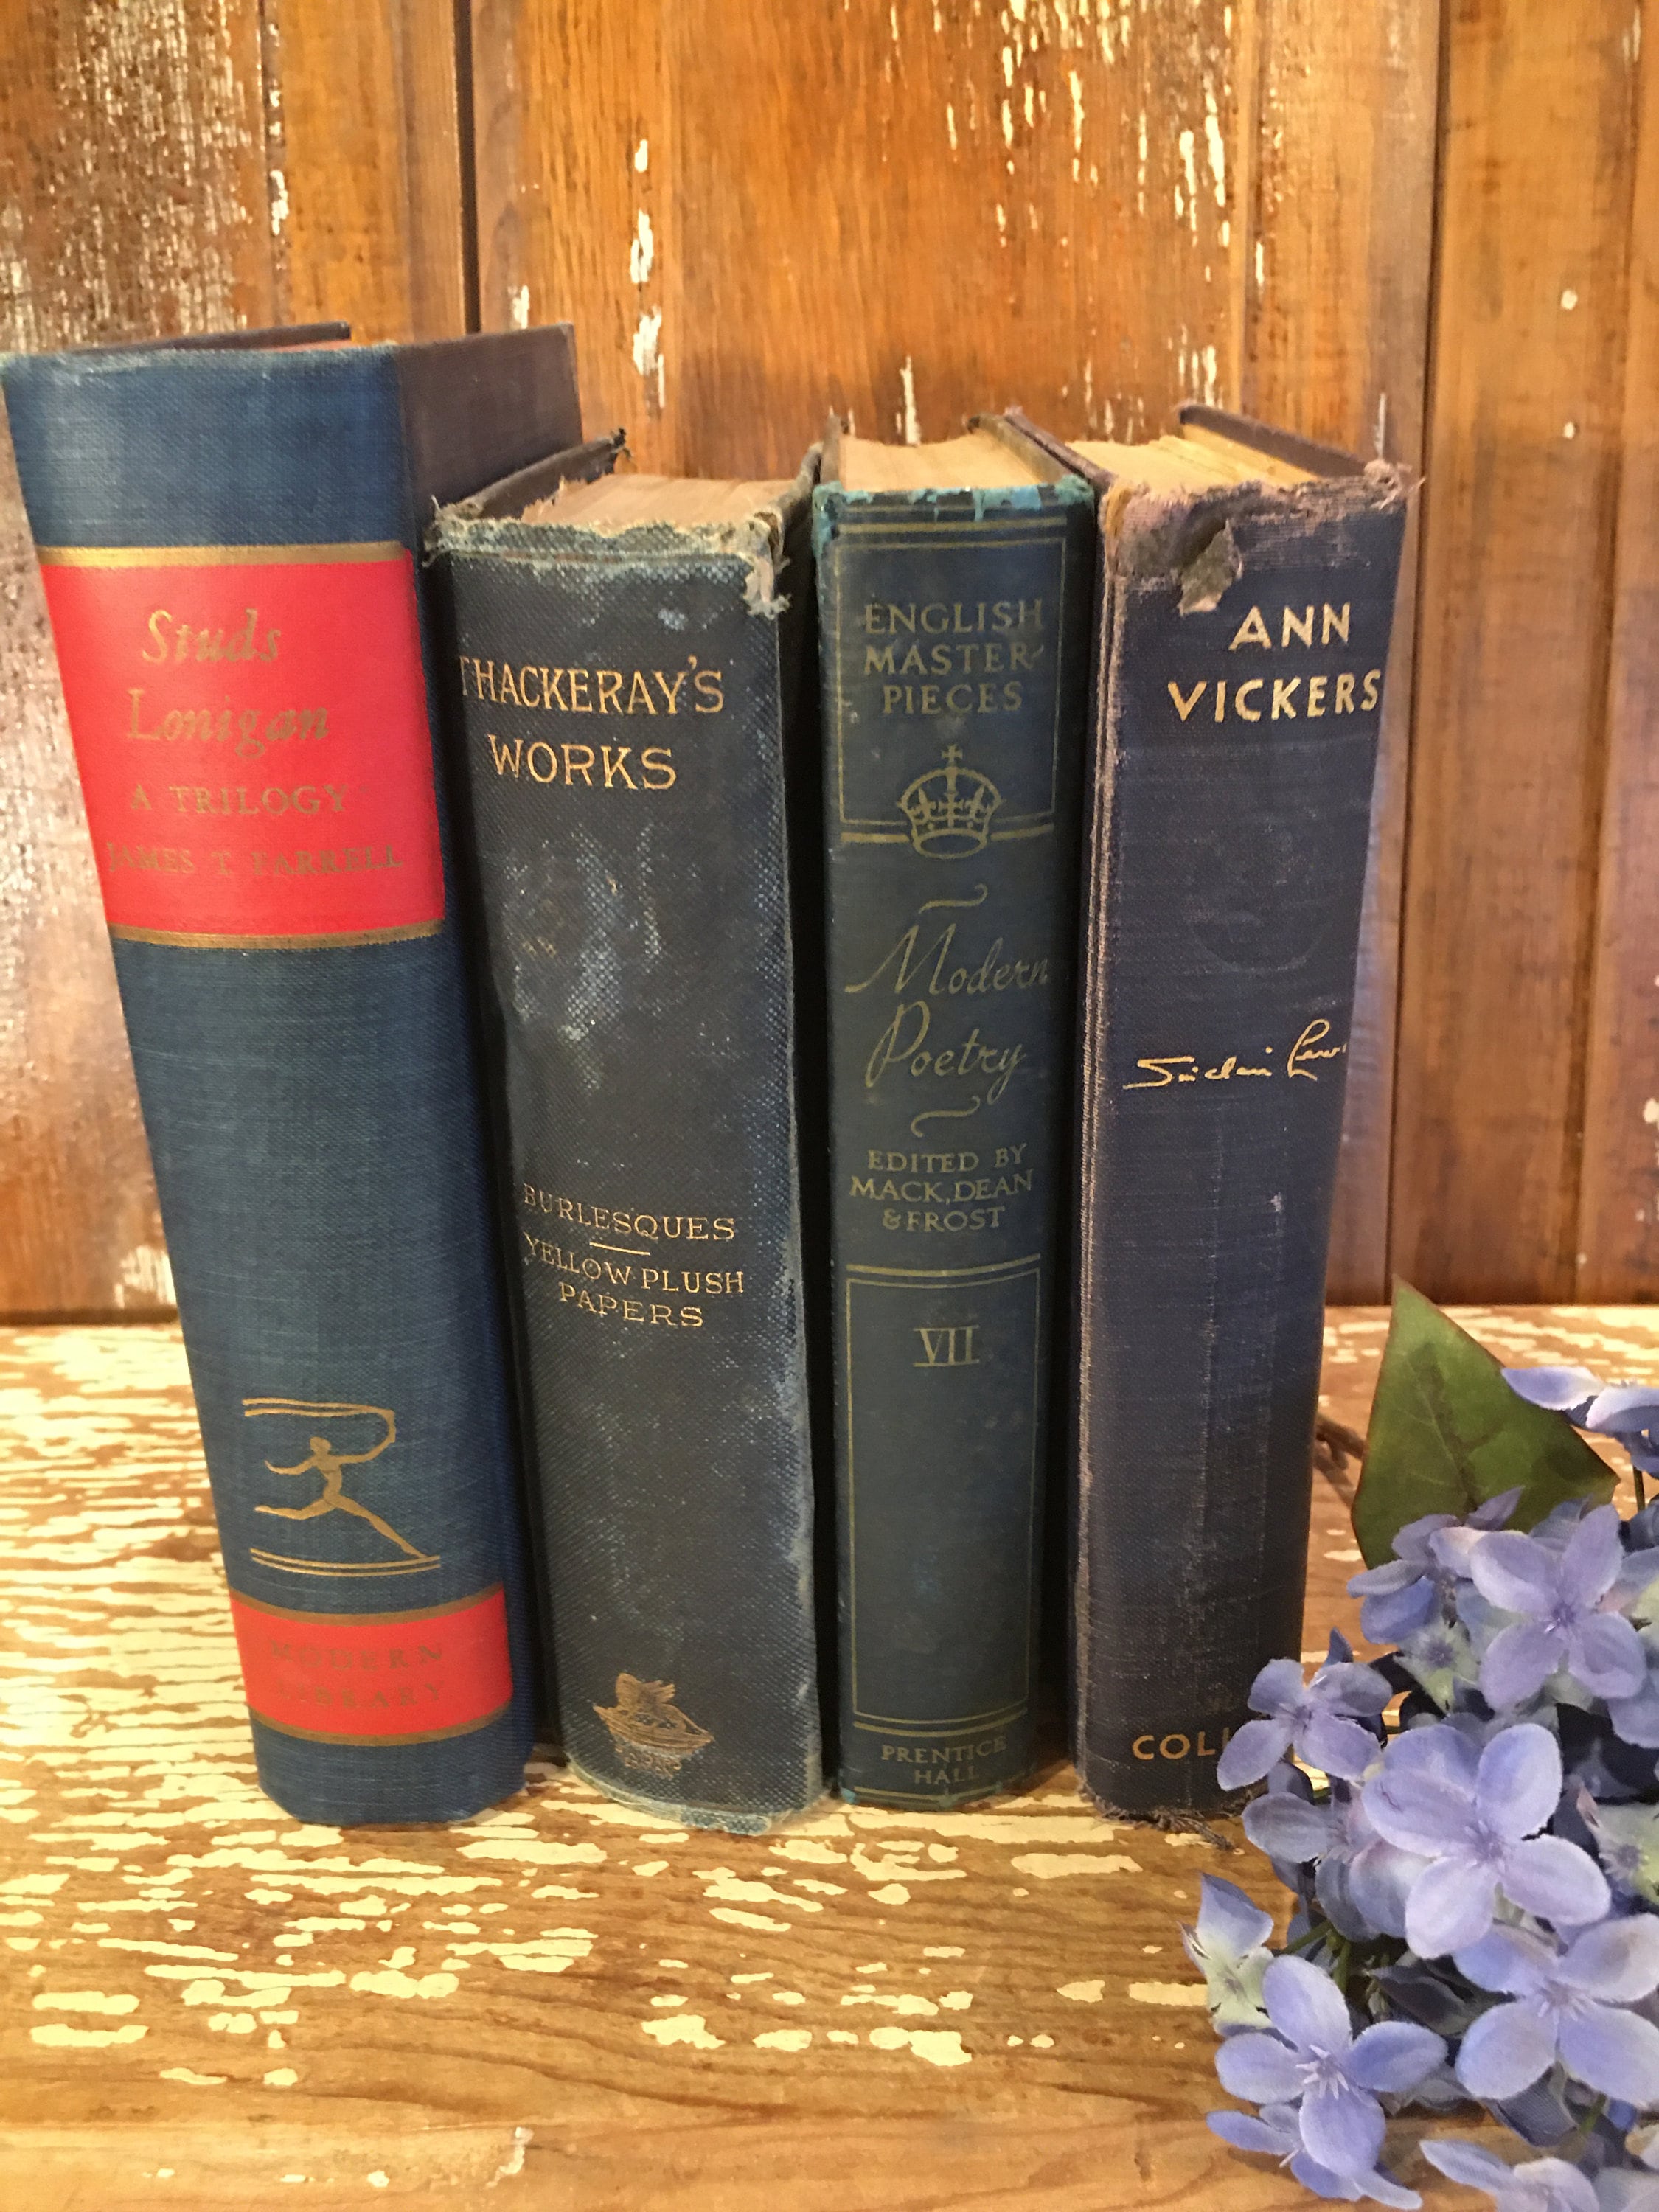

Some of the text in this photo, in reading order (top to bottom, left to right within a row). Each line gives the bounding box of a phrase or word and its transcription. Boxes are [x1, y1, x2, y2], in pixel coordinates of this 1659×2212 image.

[142, 608, 282, 662] Studs
[863, 599, 1043, 635] ENGLISH
[1228, 602, 1350, 652] ANN
[459, 654, 724, 714] THACKERAY'S
[883, 681, 1023, 714] PIECES
[1167, 669, 1382, 723] VICKERS
[126, 688, 330, 759] Lonigan
[487, 733, 677, 790] WORKS
[131, 785, 349, 814] A TRILOGY
[107, 843, 195, 874] JAMES
[251, 846, 403, 876] FARRELL
[844, 922, 1049, 995] Modern
[865, 1000, 1024, 1105] Poetry
[867, 1143, 1027, 1174] EDITED BY
[523, 1183, 737, 1241] BURLESQUES
[523, 1231, 745, 1294] YELLOW PLUSH
[558, 1281, 703, 1327] PAPERS
[912, 1324, 980, 1367] VII
[269, 1639, 444, 1671] MODERN
[881, 1736, 1007, 1764] PRENTICE
[914, 1765, 980, 1784] HALL
